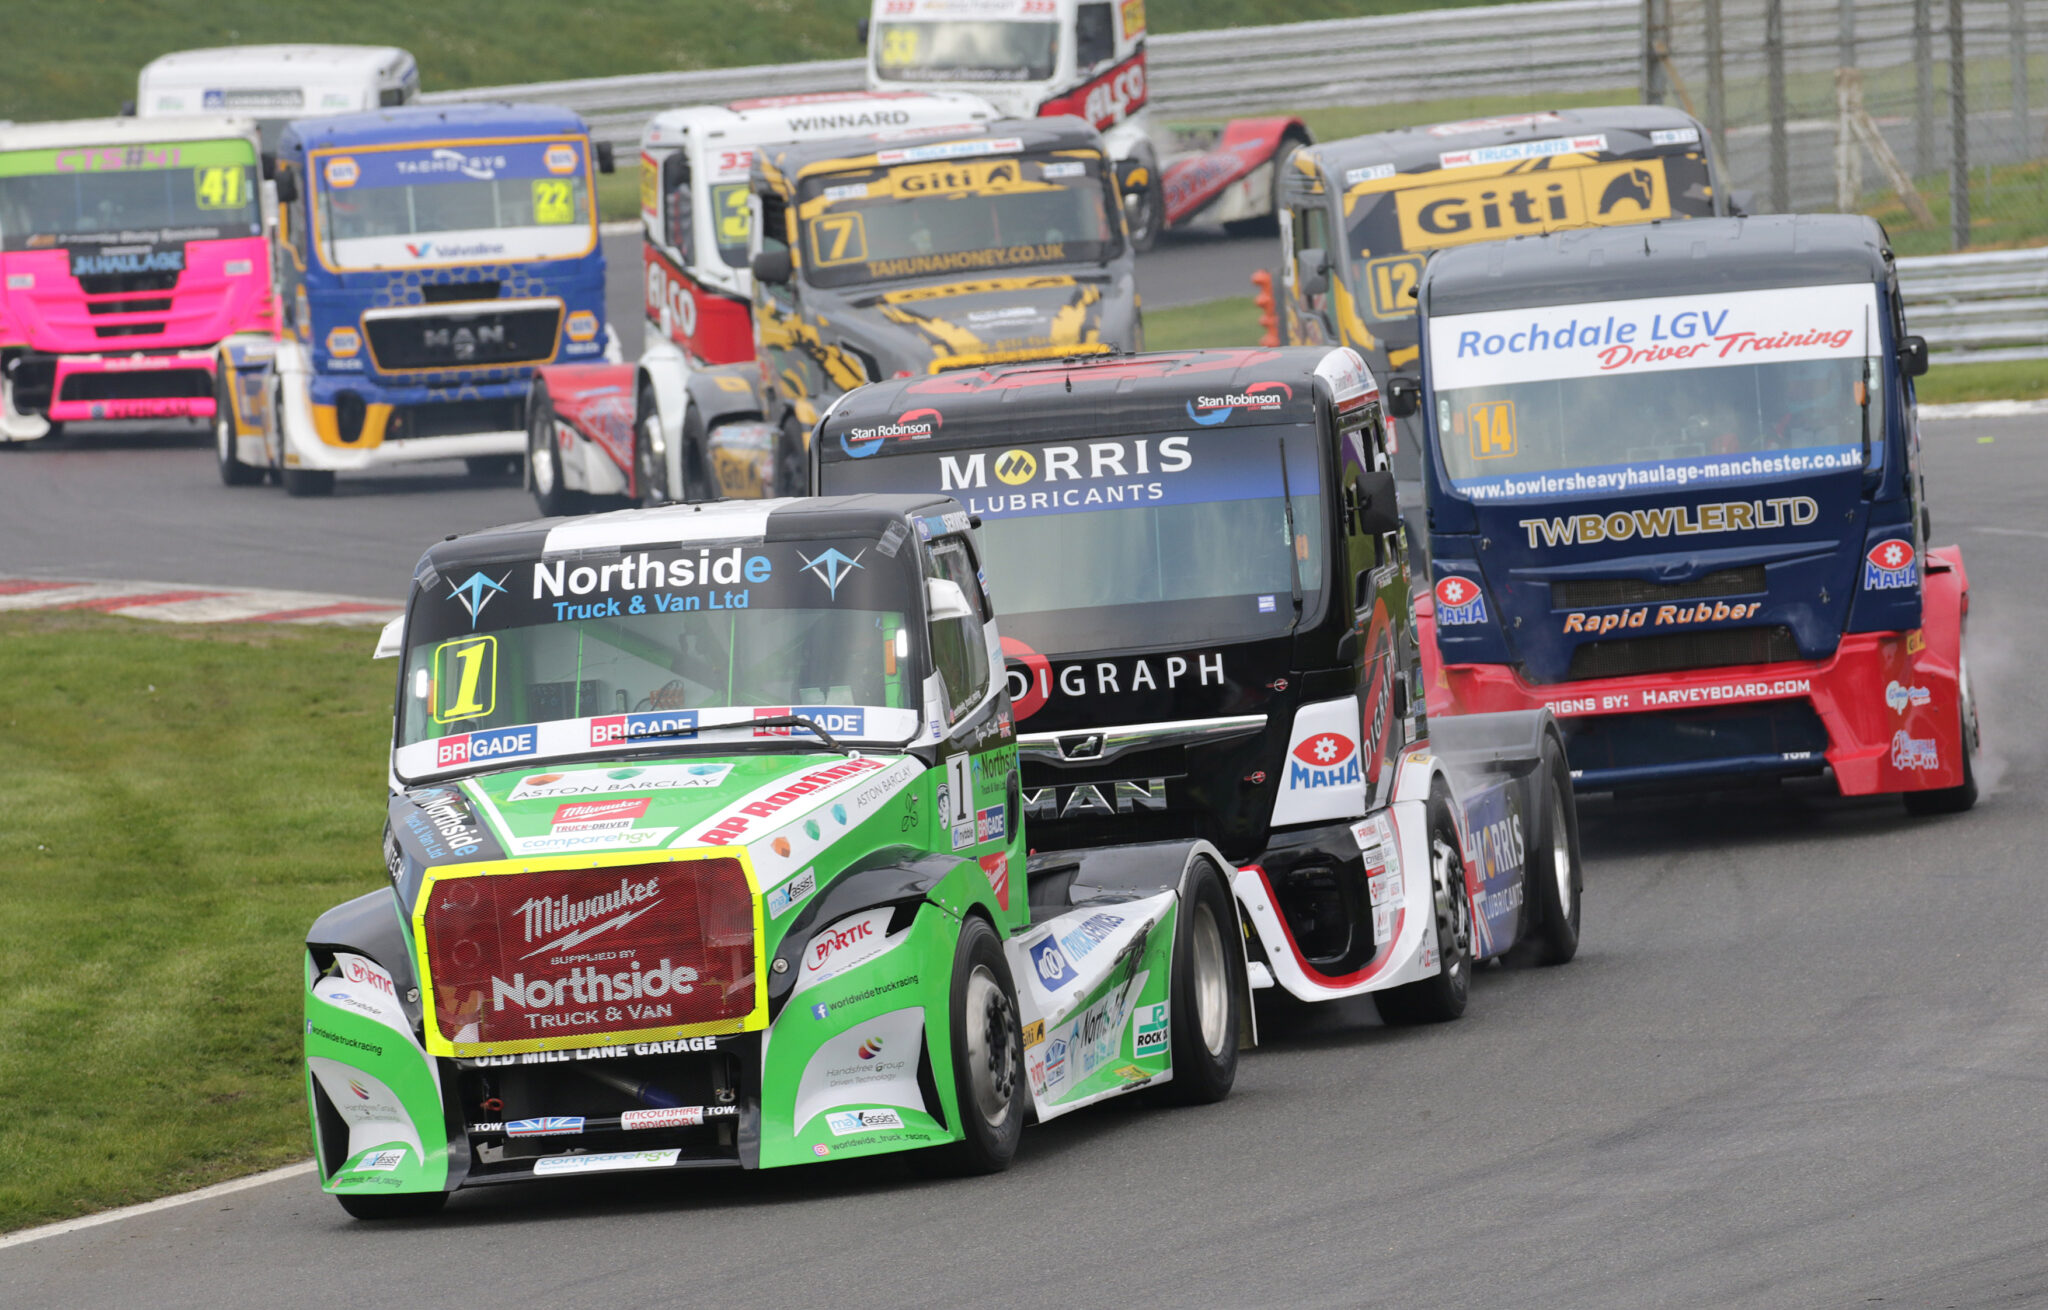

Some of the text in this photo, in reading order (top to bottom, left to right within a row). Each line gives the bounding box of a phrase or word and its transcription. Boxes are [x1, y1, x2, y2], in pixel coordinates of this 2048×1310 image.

[787, 109, 911, 132] WINNARD
[1477, 144, 1522, 163] TRUCK
[1525, 139, 1569, 157] PARTS
[200, 166, 241, 206] 41
[536, 181, 568, 208] 22
[901, 170, 972, 192] Giti
[1417, 183, 1569, 235] Giti
[822, 217, 854, 260] 7
[867, 243, 1065, 278] TAHUNAHONEY.CO.UK
[1376, 262, 1418, 312] 12
[424, 325, 505, 347] MAN
[1457, 308, 1729, 359] Rochdale LGV
[1597, 328, 1854, 371] Driver Training
[1198, 392, 1281, 408] Stan Robinson
[851, 423, 931, 440] Stan Robinson
[1473, 403, 1513, 455] 14
[1459, 448, 1863, 500] www.bowlersheavyhaulage-manchester.co.uk
[970, 481, 1165, 515] LUBRICANTS
[532, 547, 773, 600] Northside
[1864, 563, 1919, 591] MAHA
[553, 588, 749, 623] Truck & Van Ltd
[1562, 601, 1761, 635] Rapid Rubber
[443, 641, 488, 719] 1
[1006, 652, 1226, 703] DIGRAPH
[1544, 697, 1596, 714] SIGNS
[1602, 693, 1630, 711] BY:
[438, 733, 533, 766] BRIGADE
[1782, 751, 1811, 761] TOW
[513, 777, 719, 800] ASTON BARCLAY
[856, 767, 913, 808] ASTON BARCLAY
[956, 759, 967, 821] 1
[1290, 758, 1361, 791] MAHA
[559, 800, 644, 820] Milwaukee
[1022, 777, 1168, 820] MAN
[420, 796, 483, 857] Northside
[522, 830, 658, 849] comparehgv
[978, 814, 1004, 838] BRIGADE
[425, 844, 448, 860] Ltd
[513, 876, 661, 943] Milwaukee
[551, 948, 637, 966] SUPPLIED BY
[815, 920, 873, 961] PARTIC
[352, 963, 393, 996] PARTIC
[491, 958, 699, 1012] Northside
[524, 1003, 672, 1030] TRUCK & VAN
[475, 1035, 718, 1068] OLD MILL LANE GARAGE
[1137, 1032, 1161, 1047] ROCK
[826, 1060, 905, 1078] Handsfree Group
[830, 1072, 897, 1087] Driven Technology
[474, 1122, 503, 1132] TOW
[623, 1106, 701, 1121] LINCOLNSHIRE
[630, 1117, 696, 1130] RADIATORS
[707, 1105, 736, 1116] TOW
[540, 1151, 675, 1167] comparehgv
